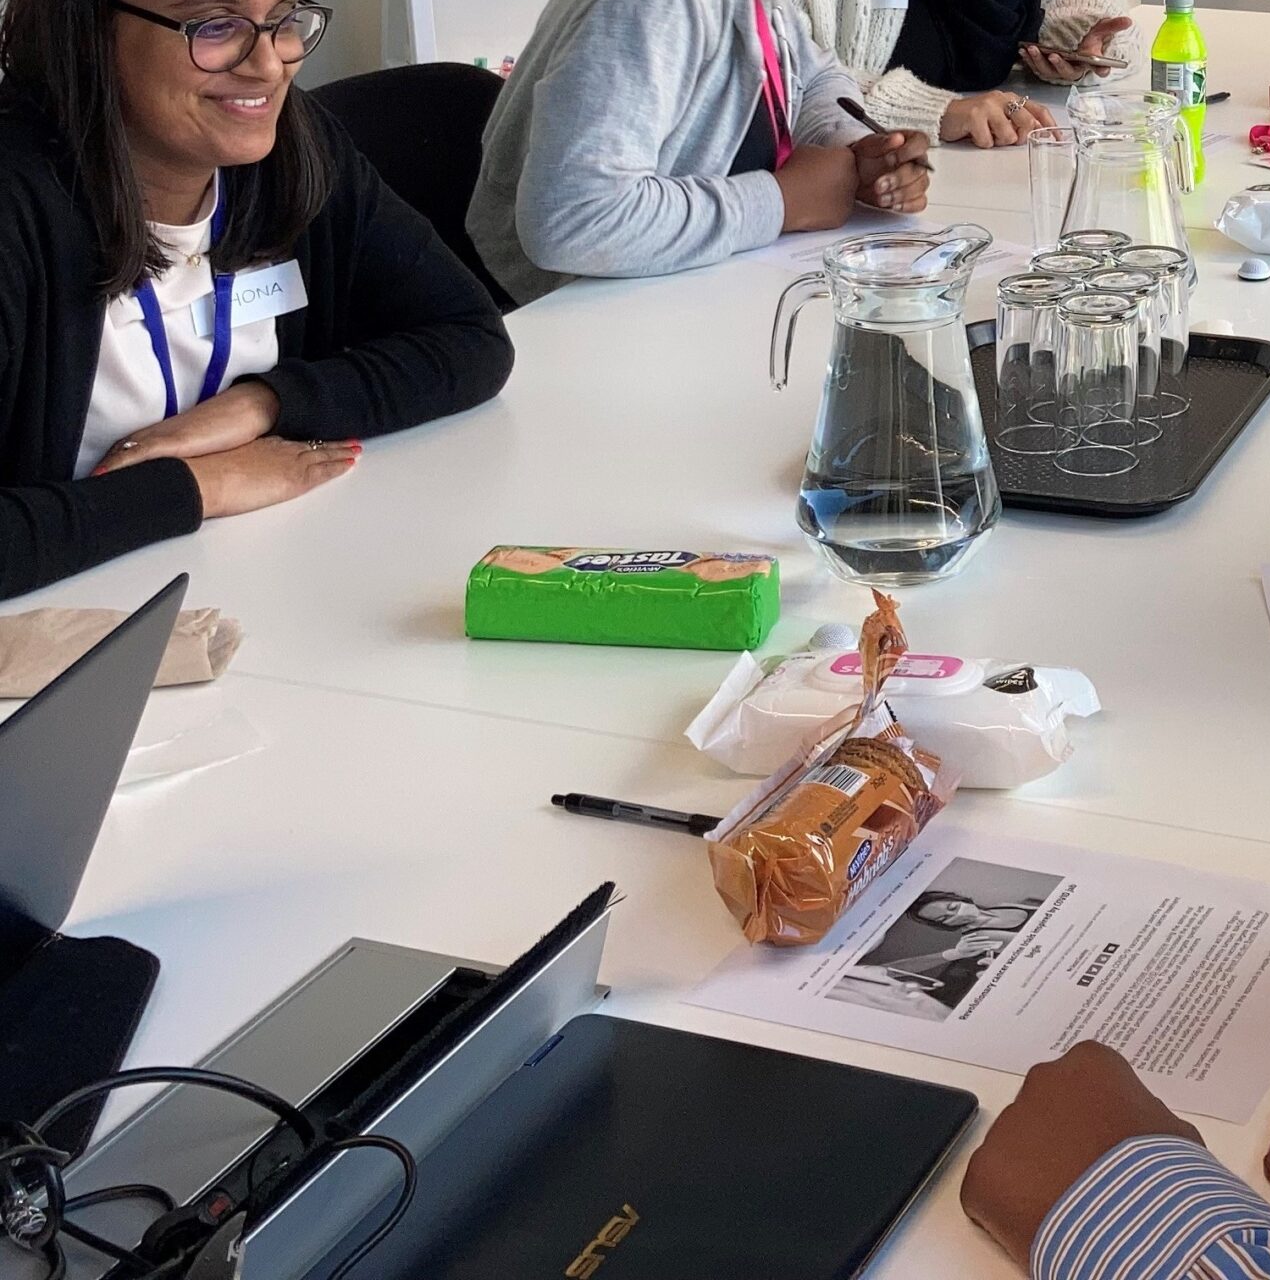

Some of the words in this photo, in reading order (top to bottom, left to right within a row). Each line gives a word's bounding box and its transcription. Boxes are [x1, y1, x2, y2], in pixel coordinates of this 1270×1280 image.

[577, 552, 686, 567] Tasties
[957, 982, 998, 1020] Revolutionary
[989, 964, 1013, 983] cancer
[1004, 946, 1028, 964] vaccine
[1019, 933, 1038, 946] trials
[1030, 912, 1056, 934] inspired
[1053, 892, 1073, 906] COVID
[1065, 883, 1080, 892] jab
[1023, 943, 1045, 958] begin
[565, 1203, 640, 1280] ASUS
